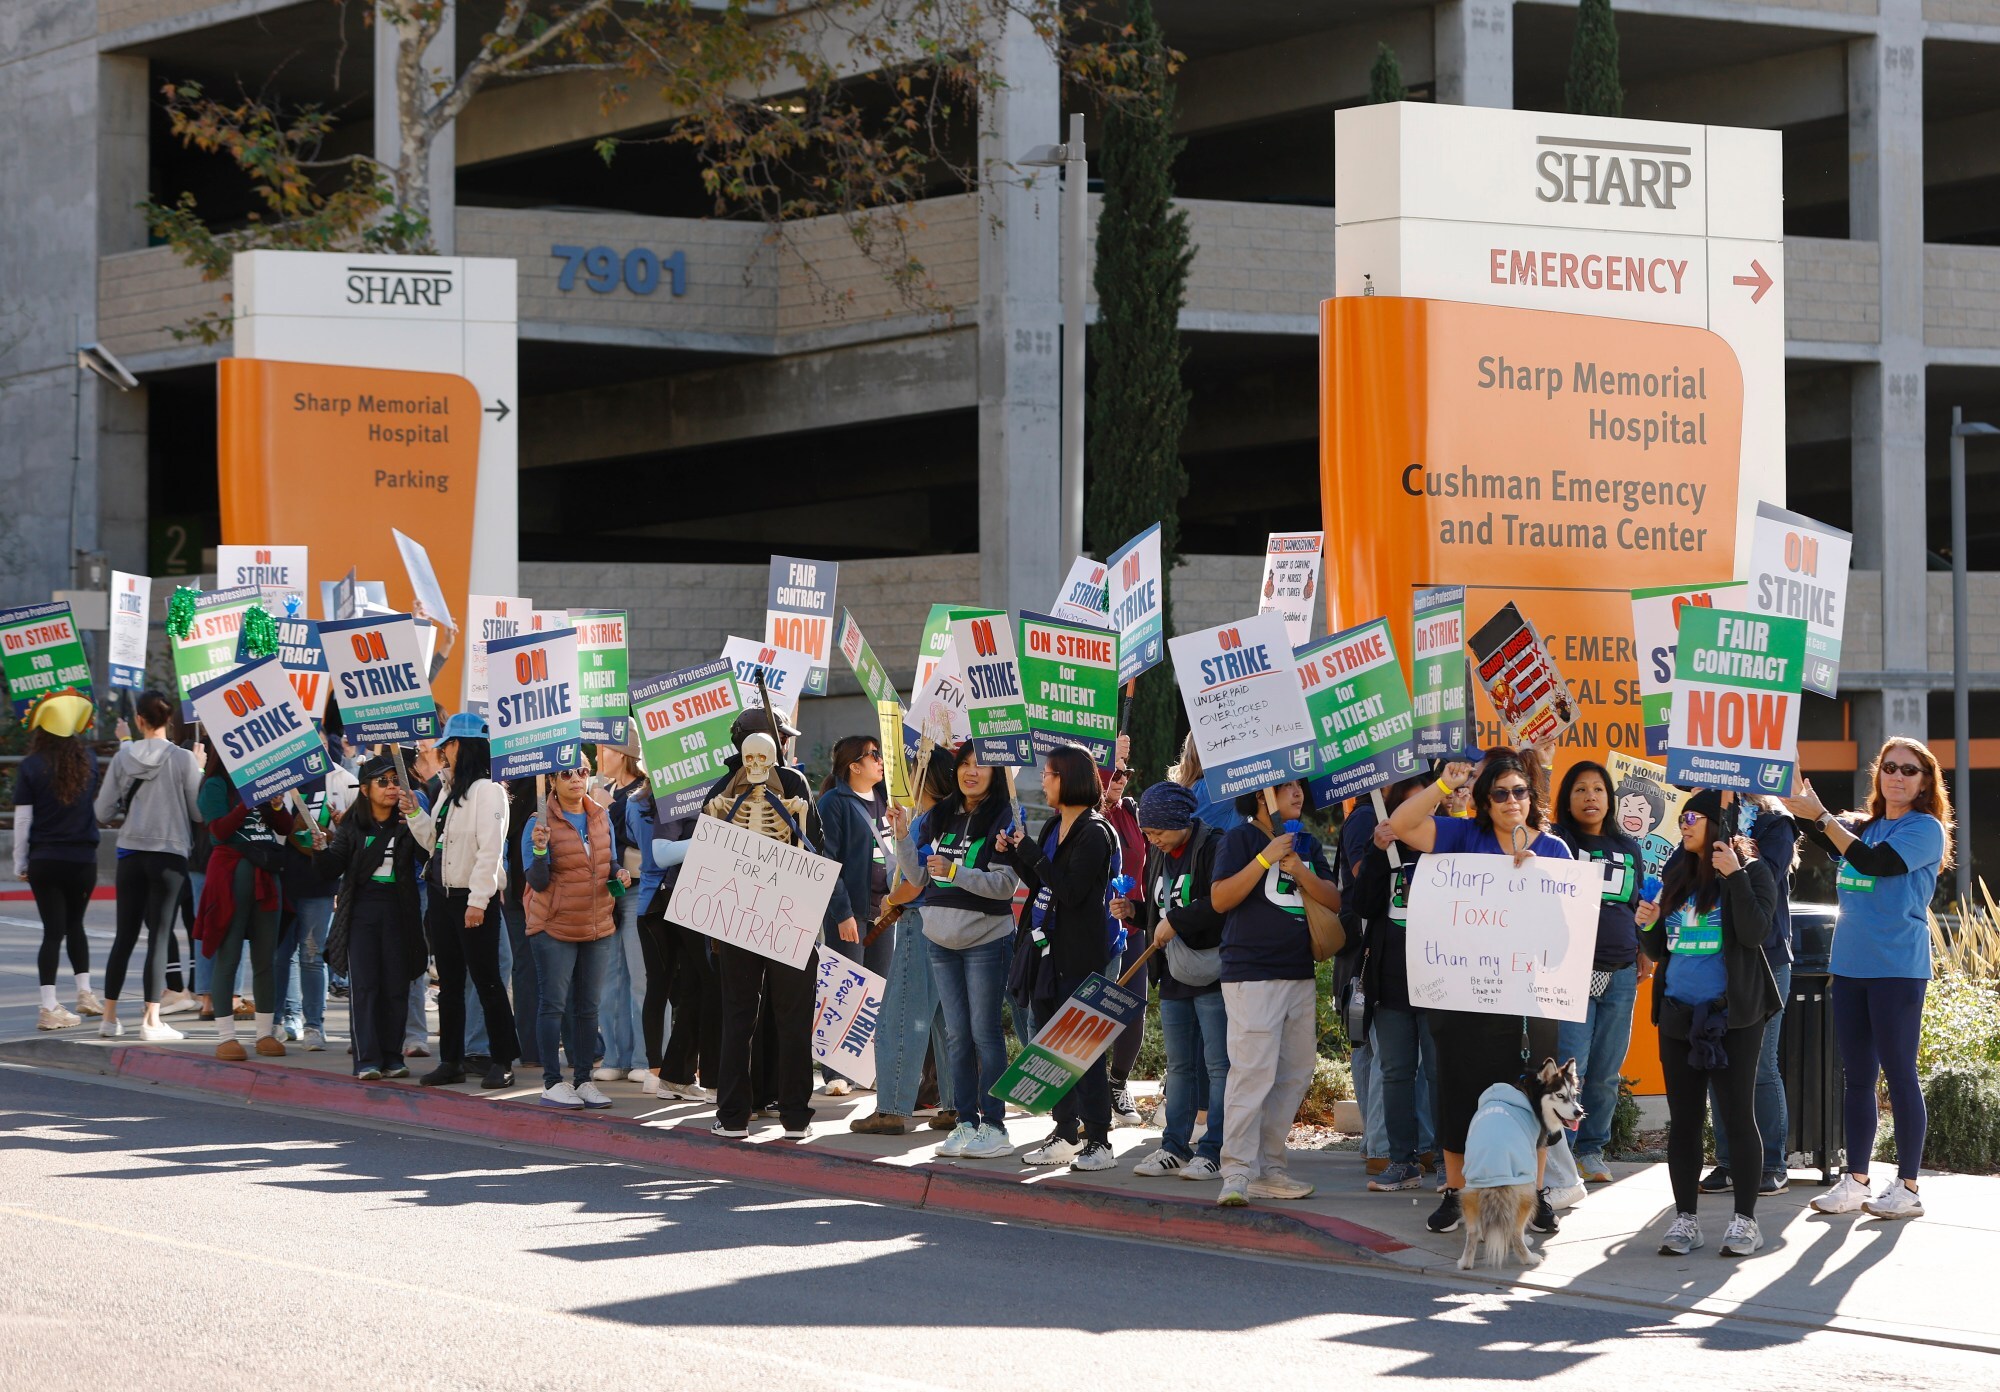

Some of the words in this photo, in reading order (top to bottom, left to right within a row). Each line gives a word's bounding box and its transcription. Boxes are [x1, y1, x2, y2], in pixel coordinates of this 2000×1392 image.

[1536, 151, 1691, 210] SHARP
[552, 245, 687, 296] 7901
[1490, 249, 1688, 294] EMERGENCY
[346, 275, 453, 306] SHARP
[1478, 356, 1562, 399] Sharp
[1573, 362, 1707, 400] Memorial
[293, 392, 351, 415] Sharp
[358, 395, 449, 415] Memorial
[368, 424, 449, 446] Hospital
[1589, 409, 1707, 450] Hospital
[374, 470, 449, 493] Parking
[1402, 463, 1541, 500] Cushman
[1552, 470, 1707, 515] Emergency
[1439, 512, 1493, 545] and
[1502, 515, 1607, 550] Trauma
[1616, 520, 1707, 552] Center
[256, 550, 271, 564] ON
[1784, 531, 1819, 578] ON
[238, 567, 288, 584] STRIKE
[789, 563, 816, 587] FAIR
[1090, 567, 1105, 585] ON
[1122, 551, 1140, 592] ON
[214, 586, 258, 603] Professional
[777, 587, 826, 609] CONTRACT
[1113, 578, 1156, 632] STRIKE
[1435, 587, 1463, 603] Professional
[1757, 573, 1836, 628] STRIKE
[496, 601, 507, 618] ON
[5, 635, 24, 649] On
[25, 623, 71, 645] STRIKE
[351, 631, 389, 663] ON
[577, 625, 588, 644] ON
[591, 623, 622, 643] STRIKE
[774, 617, 826, 661] NOW
[971, 619, 997, 657] ON
[1030, 630, 1051, 654] ON
[1057, 635, 1111, 663] STRIKE
[1218, 627, 1242, 651] ON
[1417, 627, 1427, 652] On
[1429, 618, 1459, 649] STRIKE
[1717, 617, 1770, 652] FAIR
[1812, 638, 1827, 651] Care
[31, 654, 53, 670] FOR
[208, 646, 232, 664] FOR
[515, 648, 548, 685] ON
[593, 653, 603, 666] for
[758, 648, 776, 665] ON
[1201, 644, 1271, 686] STRIKE
[1322, 633, 1386, 679] STRIKE
[1480, 651, 1505, 682] SHARP
[1501, 627, 1533, 662] NURSES
[1693, 648, 1788, 682] CONTRACT
[10, 671, 56, 693] PATIENT
[57, 665, 88, 683] CARE
[340, 662, 420, 699] STRIKE
[584, 671, 615, 689] PATIENT
[632, 684, 659, 700] Health
[660, 675, 678, 690] Care
[678, 659, 729, 687] Professional
[968, 661, 1019, 700] STRIKE
[1060, 665, 1076, 682] for
[1429, 664, 1442, 686] FOR
[223, 680, 265, 717] ON
[497, 682, 571, 727] STRIKE
[591, 694, 603, 708] and
[605, 693, 628, 707] SAFETY
[1041, 681, 1096, 707] PATIENT
[1218, 700, 1236, 709] AND
[1335, 683, 1355, 704] for
[1414, 690, 1441, 717] PATIENT
[1444, 685, 1464, 711] CARE
[355, 709, 365, 718] For
[366, 707, 380, 717] Safe
[380, 703, 403, 714] Patient
[404, 701, 419, 710] Care
[645, 709, 670, 732] On
[672, 686, 731, 722] STRIKE
[1052, 708, 1073, 724] and
[1077, 712, 1115, 730] SAFETY
[1200, 700, 1268, 725] OVERLOOKED
[1321, 694, 1385, 737] PATIENT
[1687, 690, 1788, 751] NOW
[222, 701, 302, 759] STRIKE
[357, 731, 410, 742] #TogetherWeRise
[362, 721, 398, 731] @unacuhcp
[504, 739, 513, 749] For
[514, 736, 528, 746] Safe
[529, 731, 552, 744] Patient
[553, 727, 567, 737] Care
[979, 721, 989, 734] Our
[989, 718, 1022, 733] Professions
[1265, 722, 1303, 736] VALUE
[1342, 730, 1368, 753] and
[1369, 711, 1413, 743] SAFETY
[680, 731, 707, 754] FOR
[245, 767, 257, 776] For
[255, 759, 271, 771] Safe
[269, 747, 292, 763] Patient
[291, 740, 307, 752] Care
[501, 761, 552, 776] #TogetherWeRise
[509, 751, 544, 764] @unacuhcp
[652, 752, 710, 789] PATIENT
[1227, 759, 1272, 779] @unacuhcp
[1615, 760, 1630, 772] MY
[1692, 756, 1740, 772] @unacuhcp
[255, 768, 291, 788] @unacuhcp
[1221, 769, 1285, 795] #TogetherWeRise
[1325, 771, 1389, 800] #TogetherWeRise
[1331, 762, 1376, 784] @unacuhcp
[1678, 768, 1750, 788] #TogetherWeRise
[253, 774, 304, 801] #TogetherWeRise
[1622, 777, 1645, 792] NICU
[1647, 785, 1677, 803] NURSE
[696, 821, 751, 858] STILL
[757, 840, 826, 882] WAITING
[733, 858, 760, 879] FOR
[767, 872, 777, 886] A
[1431, 858, 1495, 896] Sharp
[1508, 877, 1527, 893] is
[1541, 878, 1577, 897] more
[694, 865, 794, 923] FAIR
[674, 886, 812, 960] CONTRACT
[1424, 941, 1467, 967] than
[1480, 954, 1499, 976] my
[1470, 977, 1480, 985] Be
[1528, 983, 1548, 993] Some
[840, 996, 881, 1058] STRIKE
[1039, 1006, 1116, 1061] NOW
[1019, 1053, 1072, 1088] CONTRACT
[1008, 1076, 1047, 1105] FAIR
